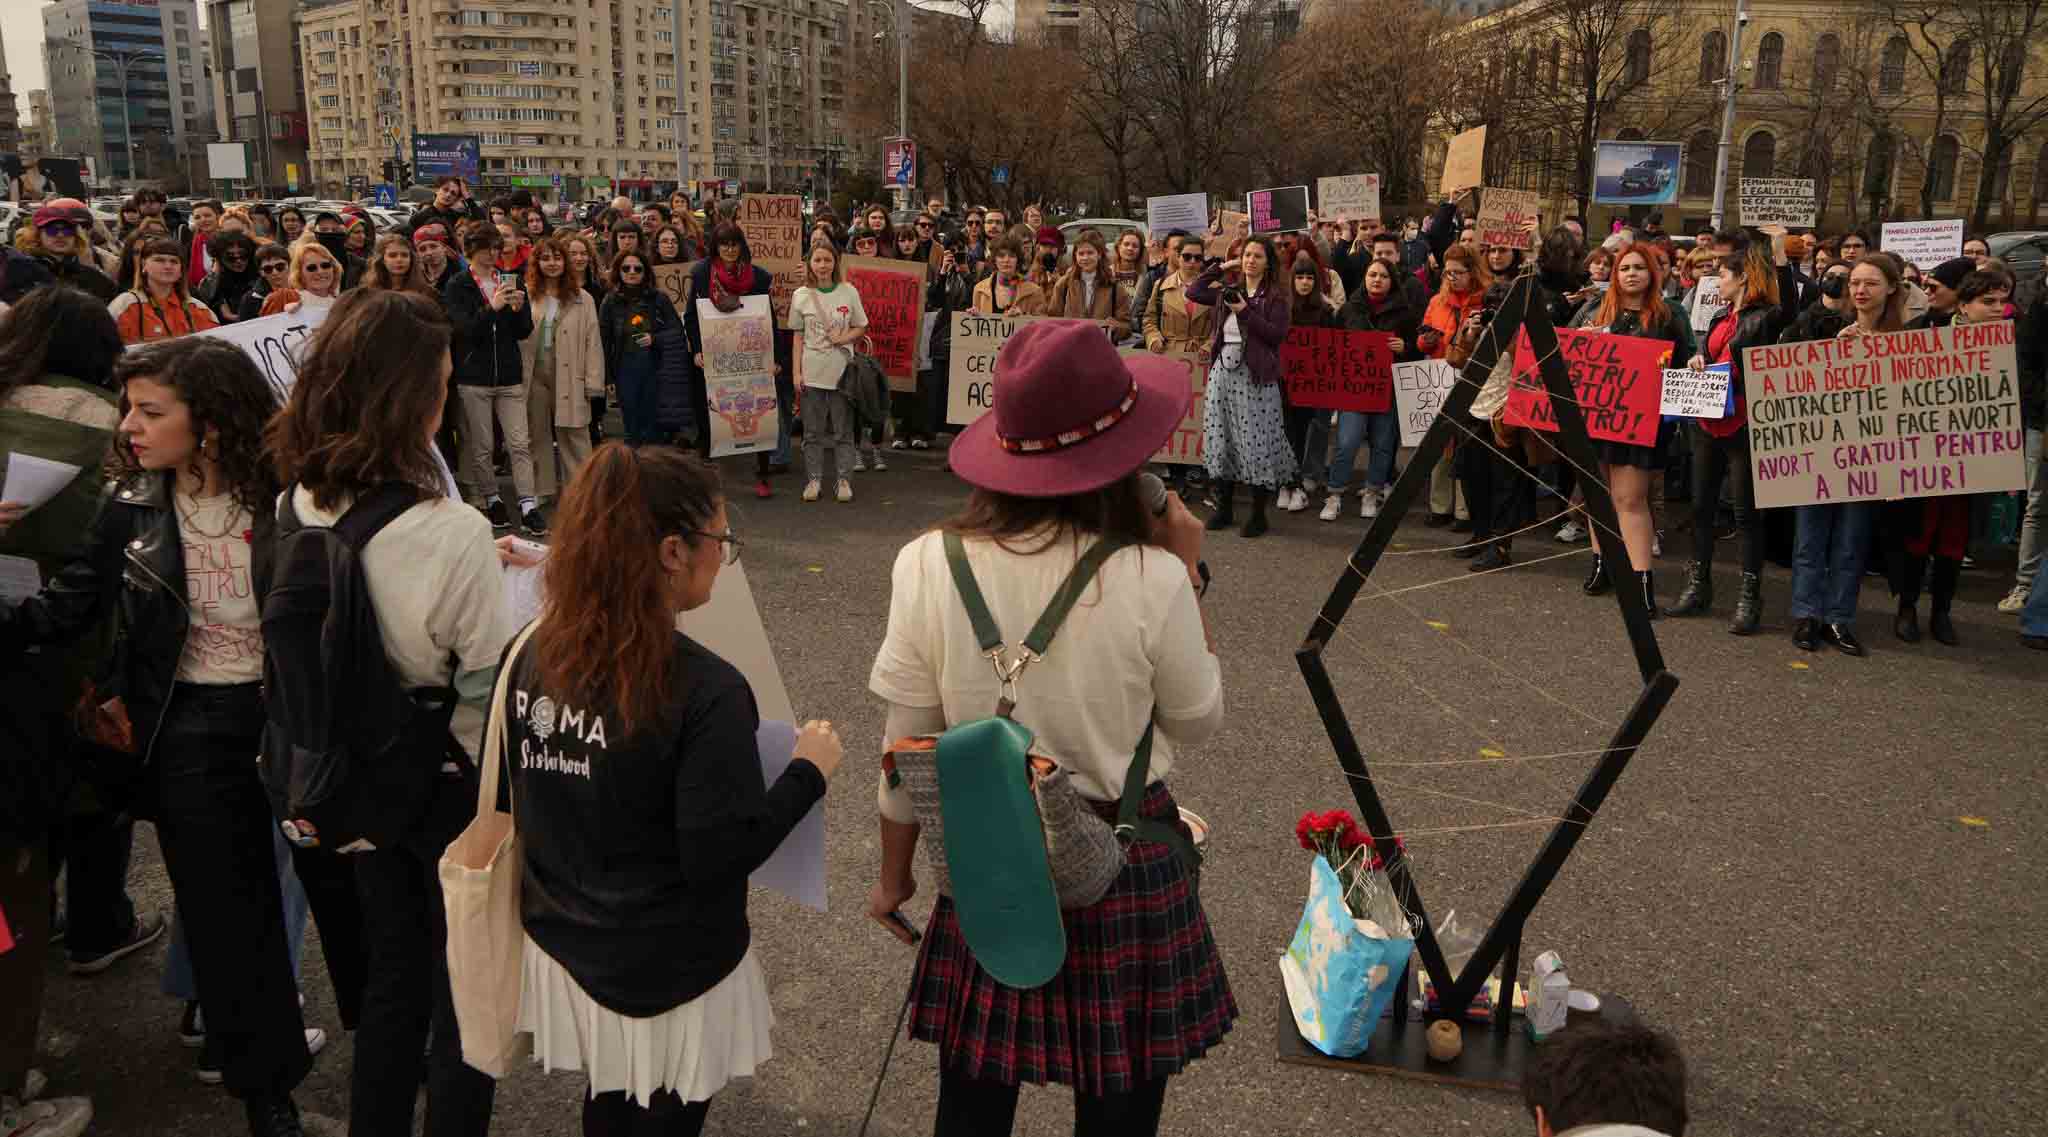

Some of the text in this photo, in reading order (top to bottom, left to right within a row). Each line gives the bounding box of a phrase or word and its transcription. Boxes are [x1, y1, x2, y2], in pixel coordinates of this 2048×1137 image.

[1751, 338, 1853, 371] EDUCAȚIE
[1953, 322, 2016, 349] PENTRU
[1751, 370, 2012, 425] CONTRACEPȚIE ACCESIBILĂ
[1763, 350, 1991, 396] A LUA DECIZII INFORMATE
[1753, 402, 2017, 452] PENTRU A NU FACE AVORT
[1758, 429, 2022, 481] AVORT GRATUIT PENTRU
[1816, 461, 1966, 500] A NU MURI
[515, 689, 607, 749] ROMA
[520, 738, 591, 781] Sisterhood
